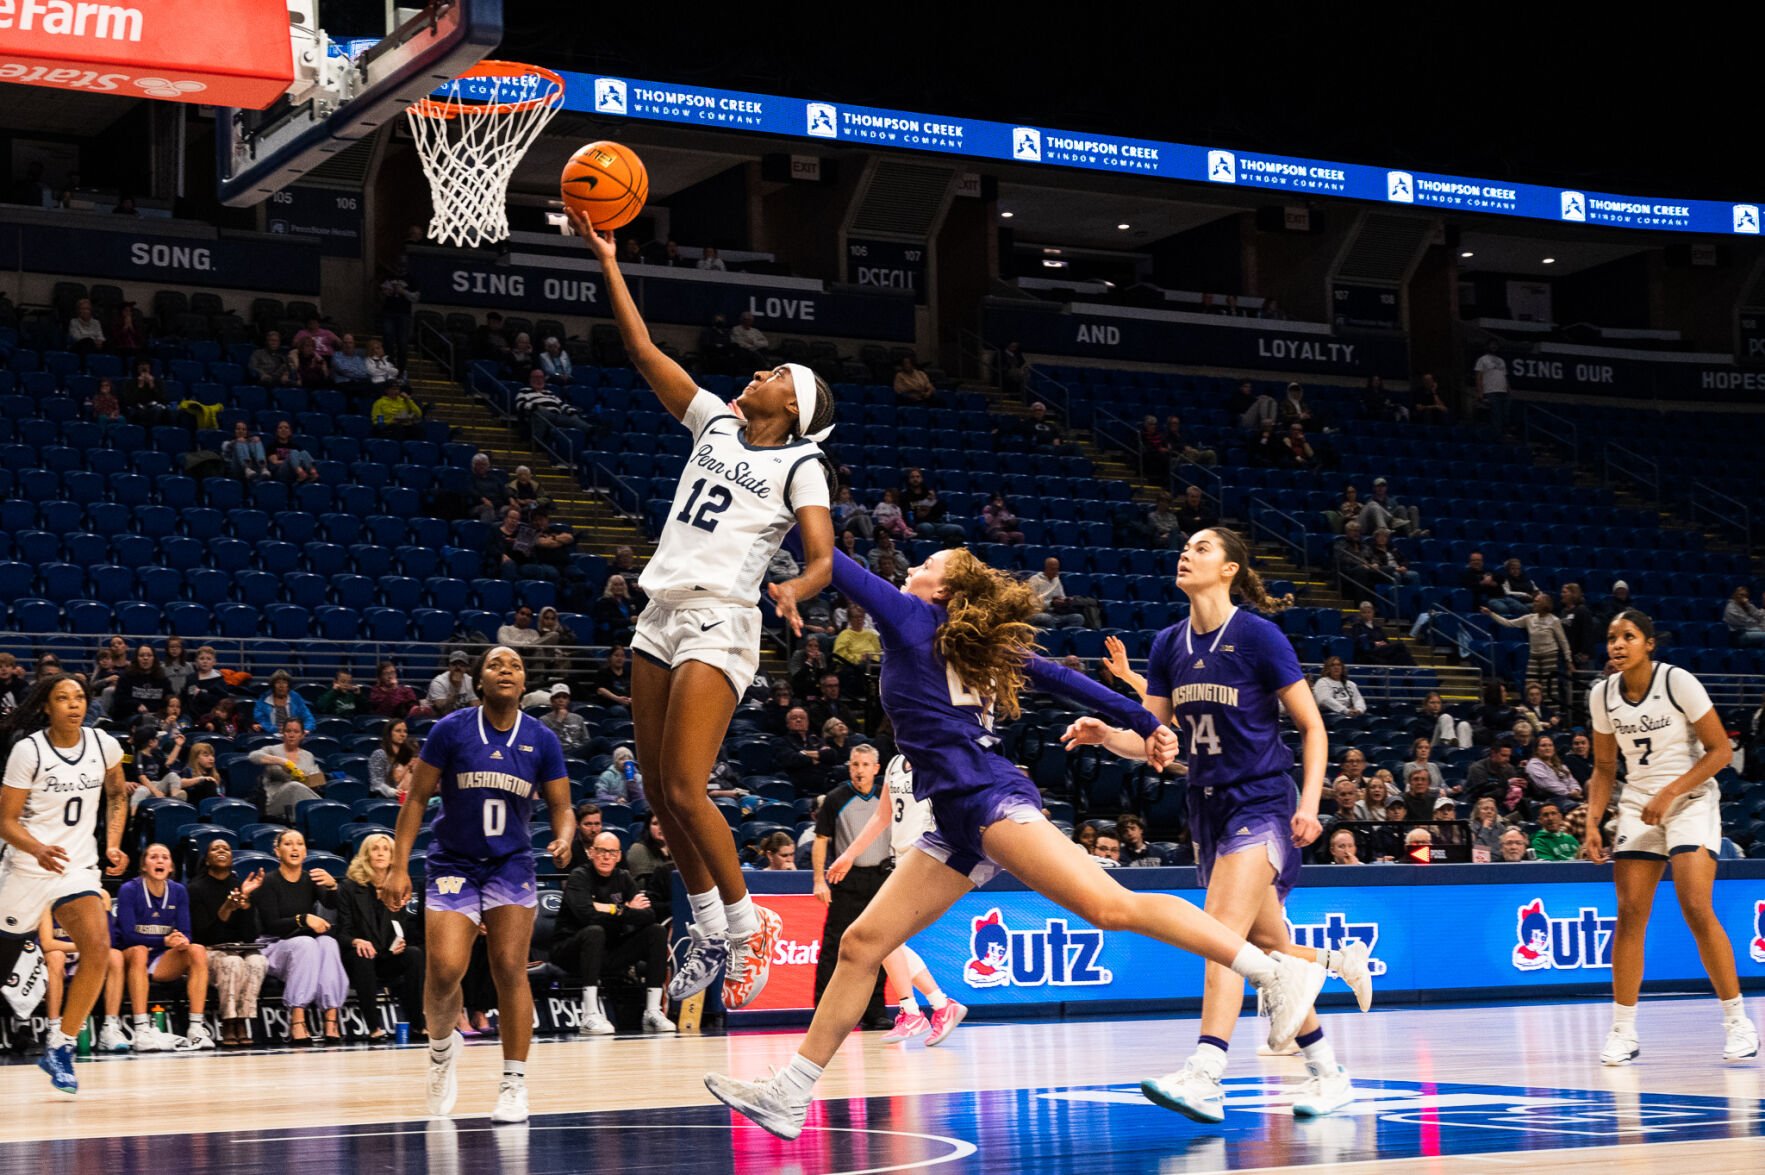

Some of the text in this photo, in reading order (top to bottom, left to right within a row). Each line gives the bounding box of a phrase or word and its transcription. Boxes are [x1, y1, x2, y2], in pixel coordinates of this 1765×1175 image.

[0, 63, 130, 91] State
[633, 88, 763, 114] THOMPSON CREEK
[634, 104, 762, 125] WINDOW COMPANY
[842, 112, 963, 137] THOMPSON CREEK
[843, 128, 963, 149] WINDOW COMPANY
[1046, 136, 1159, 160] THOMPSON CREEK
[792, 162, 817, 174] EXIT
[1047, 151, 1159, 170] WINDOW COMPANY
[1239, 158, 1345, 181] THOMPSON CREEK
[1240, 173, 1345, 191] WINDOW COMPANY
[1416, 179, 1516, 200] THOMPSON CREEK
[336, 196, 358, 211] 106
[1417, 193, 1516, 211] WINDOW COMPANY
[1588, 198, 1690, 217] THOMPSON CREEK
[1590, 212, 1689, 227] WINDOW COMPANY
[850, 245, 922, 263] 106 107
[452, 270, 598, 303] SING OUR
[750, 296, 816, 321] LOVE
[1076, 323, 1121, 346] AND
[1512, 358, 1614, 384] SING OUR
[1701, 371, 1765, 390] HOPES
[690, 444, 772, 499] Penn State
[676, 478, 733, 533] 12
[1185, 713, 1223, 755] 14
[1639, 714, 1672, 733] State
[1633, 737, 1653, 766] 7
[456, 771, 532, 798] WASHINGTON
[64, 796, 83, 827] 0
[482, 798, 507, 837] 0
[894, 797, 905, 823] 3
